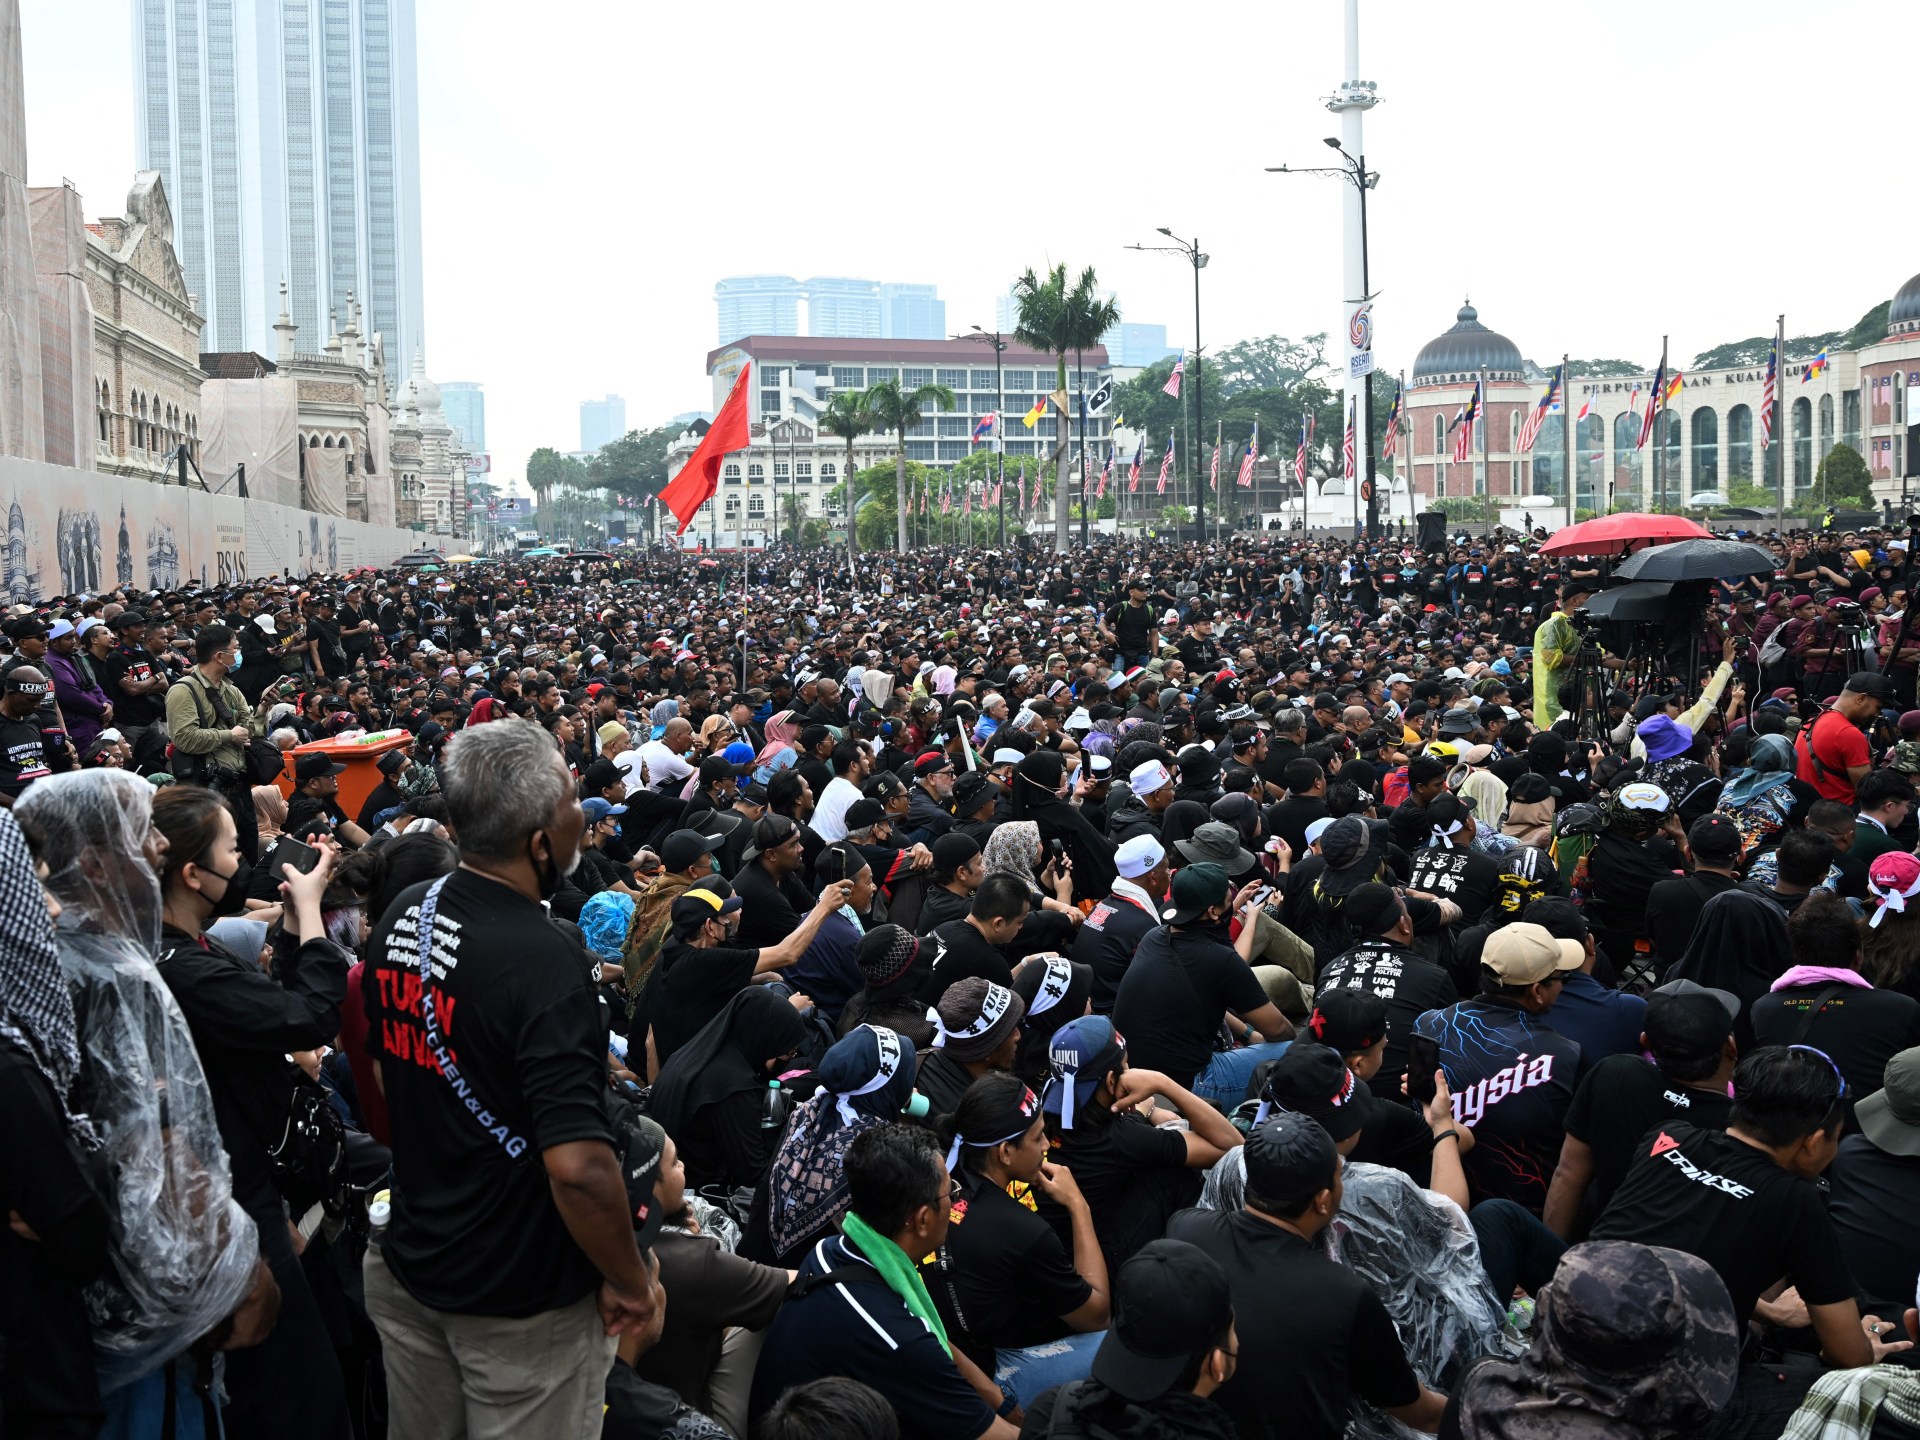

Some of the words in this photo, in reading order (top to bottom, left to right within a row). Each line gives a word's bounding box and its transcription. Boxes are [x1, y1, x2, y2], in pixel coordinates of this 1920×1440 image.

[1351, 352, 1370, 369] ASEAN
[1583, 376, 1711, 394] PERPUSTAAN
[1725, 372, 1765, 384] KUAL
[1785, 361, 1830, 377] LUMR
[216, 550, 245, 585] BSAS
[1372, 976, 1396, 988] URA
[375, 968, 456, 1036] TURN
[1662, 1149, 1755, 1199] DAINESE
